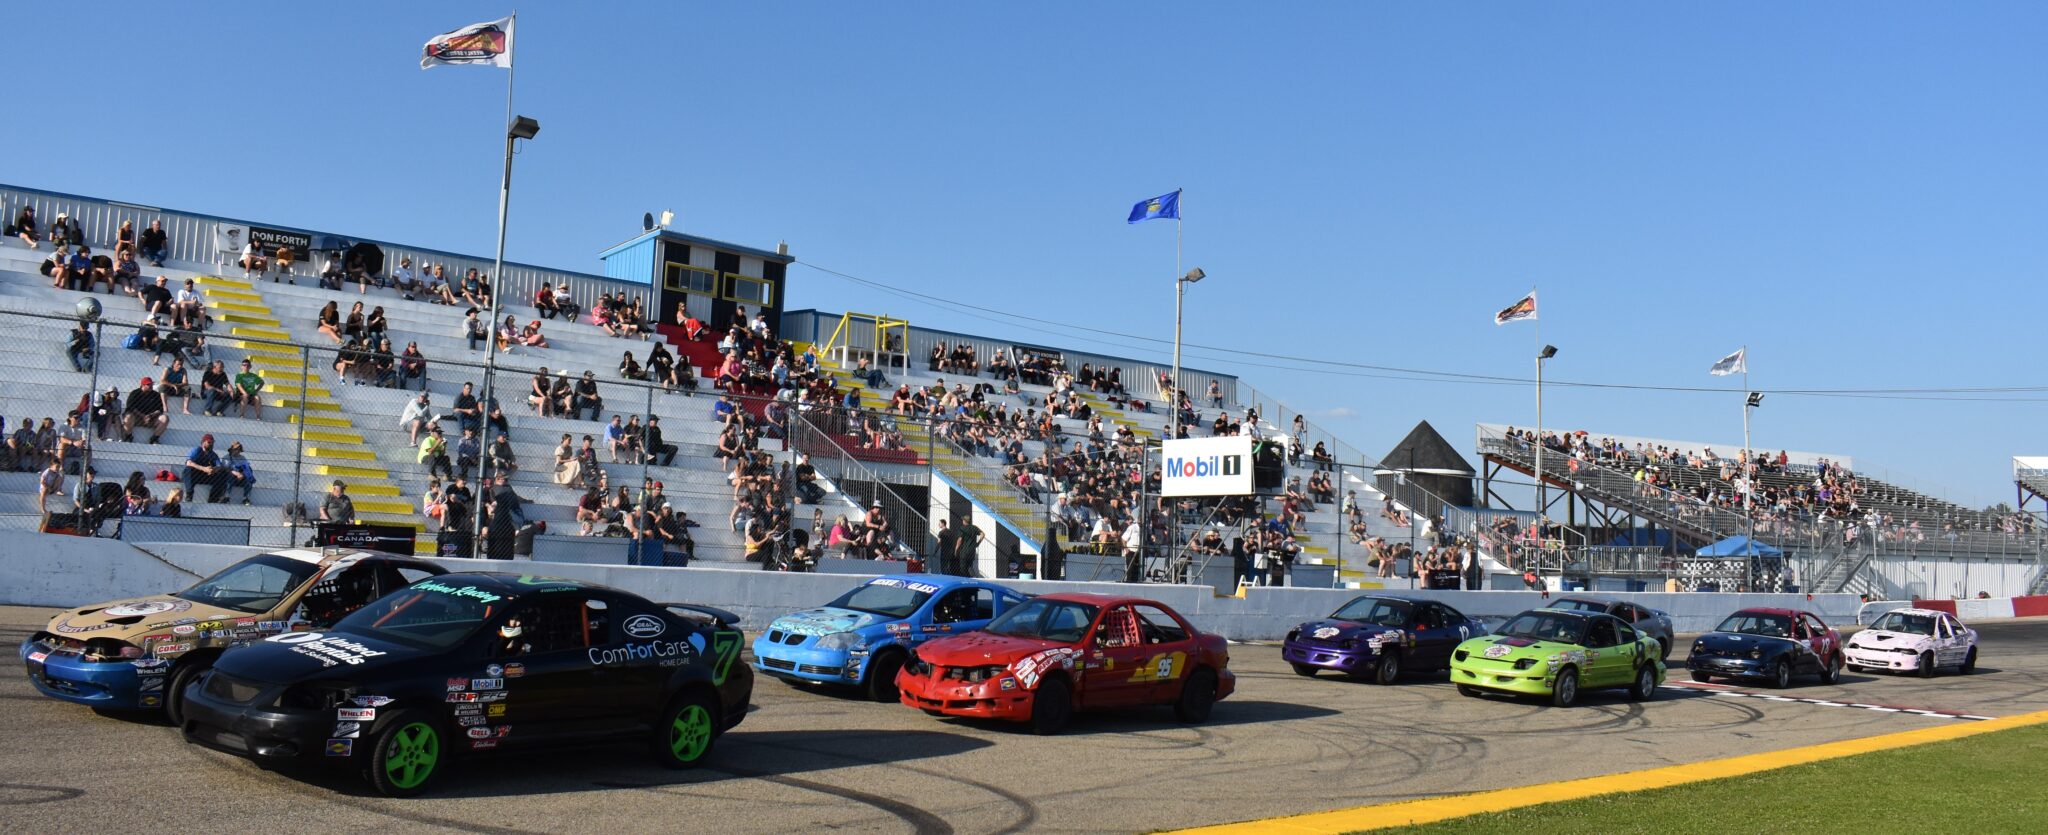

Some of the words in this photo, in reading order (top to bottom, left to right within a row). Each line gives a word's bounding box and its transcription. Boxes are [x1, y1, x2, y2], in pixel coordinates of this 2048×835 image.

[252, 231, 274, 242] DON
[275, 234, 308, 247] FORTH
[1167, 455, 1219, 478] Mobil
[337, 535, 380, 543] CANADA
[907, 582, 938, 594] GLASS
[319, 636, 387, 657] United
[588, 640, 690, 665] ComForCare
[297, 640, 366, 666] Rentals
[712, 631, 742, 687] 7
[659, 658, 676, 667] HOME
[676, 656, 691, 666] CARE
[136, 667, 167, 675] WHELEN
[1157, 658, 1174, 678] 95
[473, 679, 494, 688] Mobil
[447, 692, 478, 701] ARP
[340, 710, 373, 718] WHELEN
[488, 706, 506, 714] OMP
